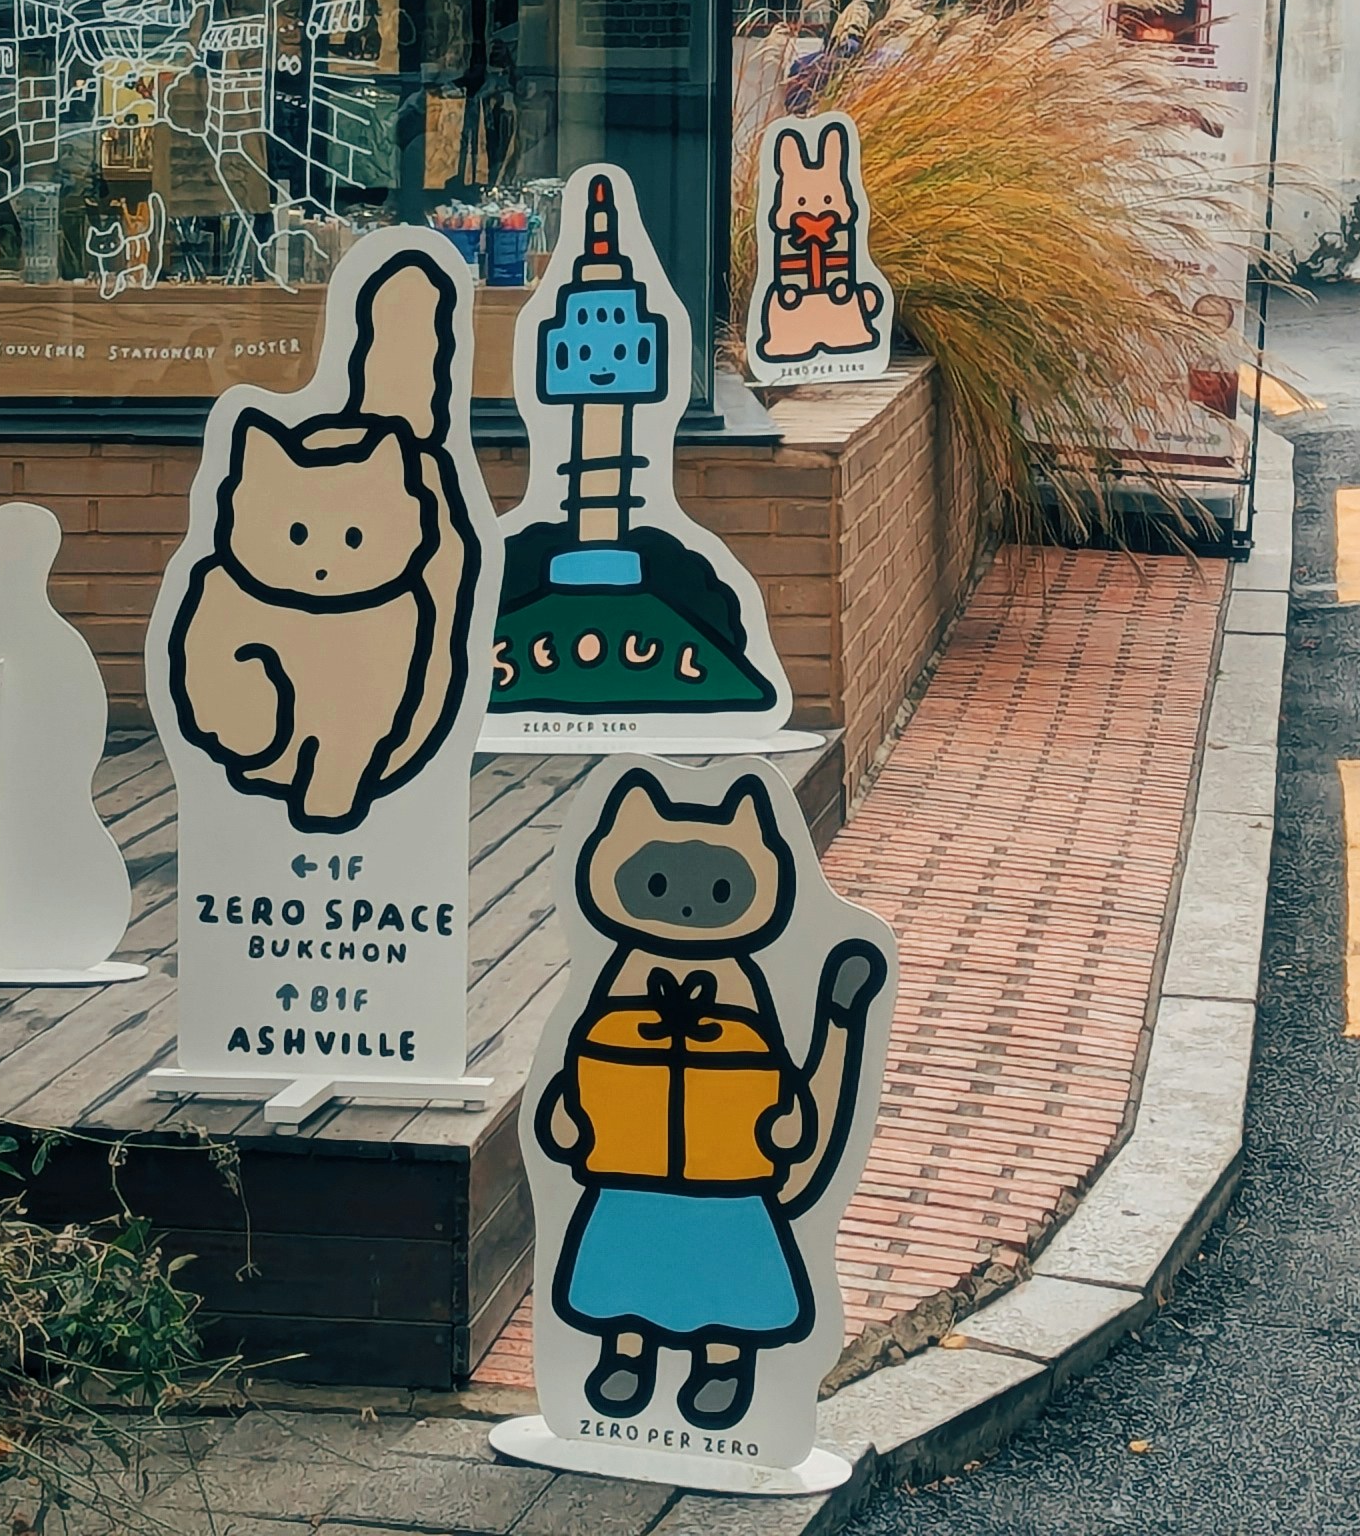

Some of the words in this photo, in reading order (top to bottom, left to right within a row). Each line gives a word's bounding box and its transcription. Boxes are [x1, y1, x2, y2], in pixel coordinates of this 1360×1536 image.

[108, 345, 216, 361] STATIONERY
[235, 338, 301, 358] POSTER
[492, 632, 702, 687] SEOUL
[523, 721, 561, 733] ZERO
[567, 721, 594, 733] PER
[602, 722, 637, 732] ZERO
[327, 855, 364, 881] 1F
[196, 894, 305, 926] ZERO
[325, 899, 455, 936] SPACE
[248, 935, 407, 964] BUKCHON
[227, 1025, 415, 1062] ASHVILLE
[580, 1419, 639, 1441] ZERO
[648, 1428, 690, 1449] PER
[703, 1437, 759, 1457] ZERO
